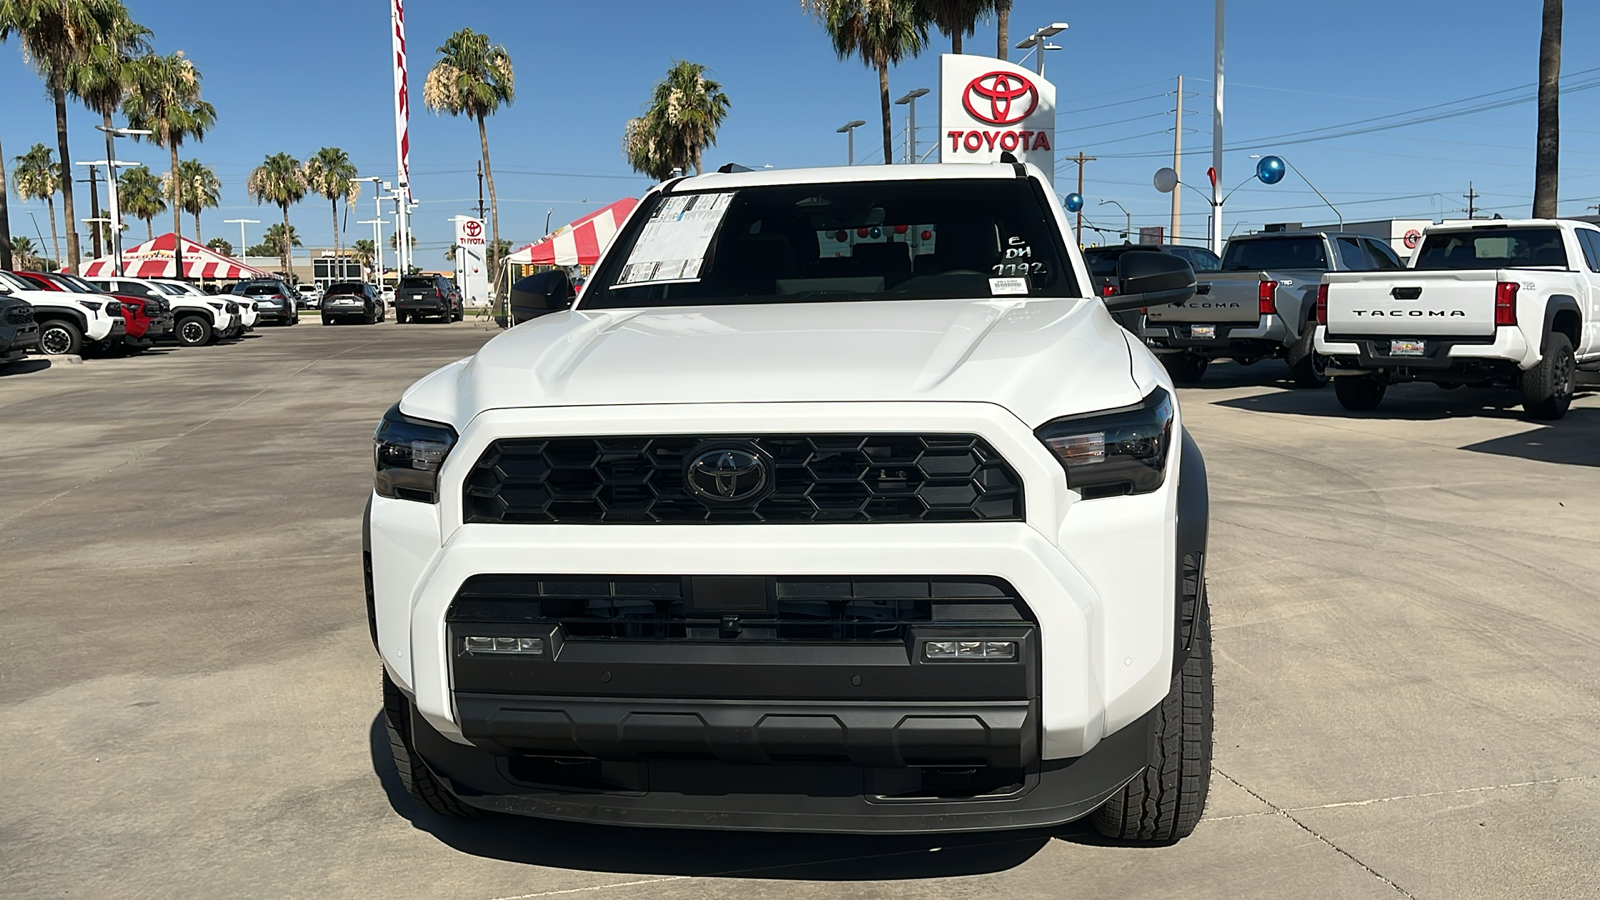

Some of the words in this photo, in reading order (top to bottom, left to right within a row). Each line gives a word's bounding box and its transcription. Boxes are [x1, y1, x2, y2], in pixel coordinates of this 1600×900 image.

[947, 130, 1052, 152] TOYOTA
[992, 261, 1047, 276] 7792
[1352, 310, 1466, 318] TACOMA
